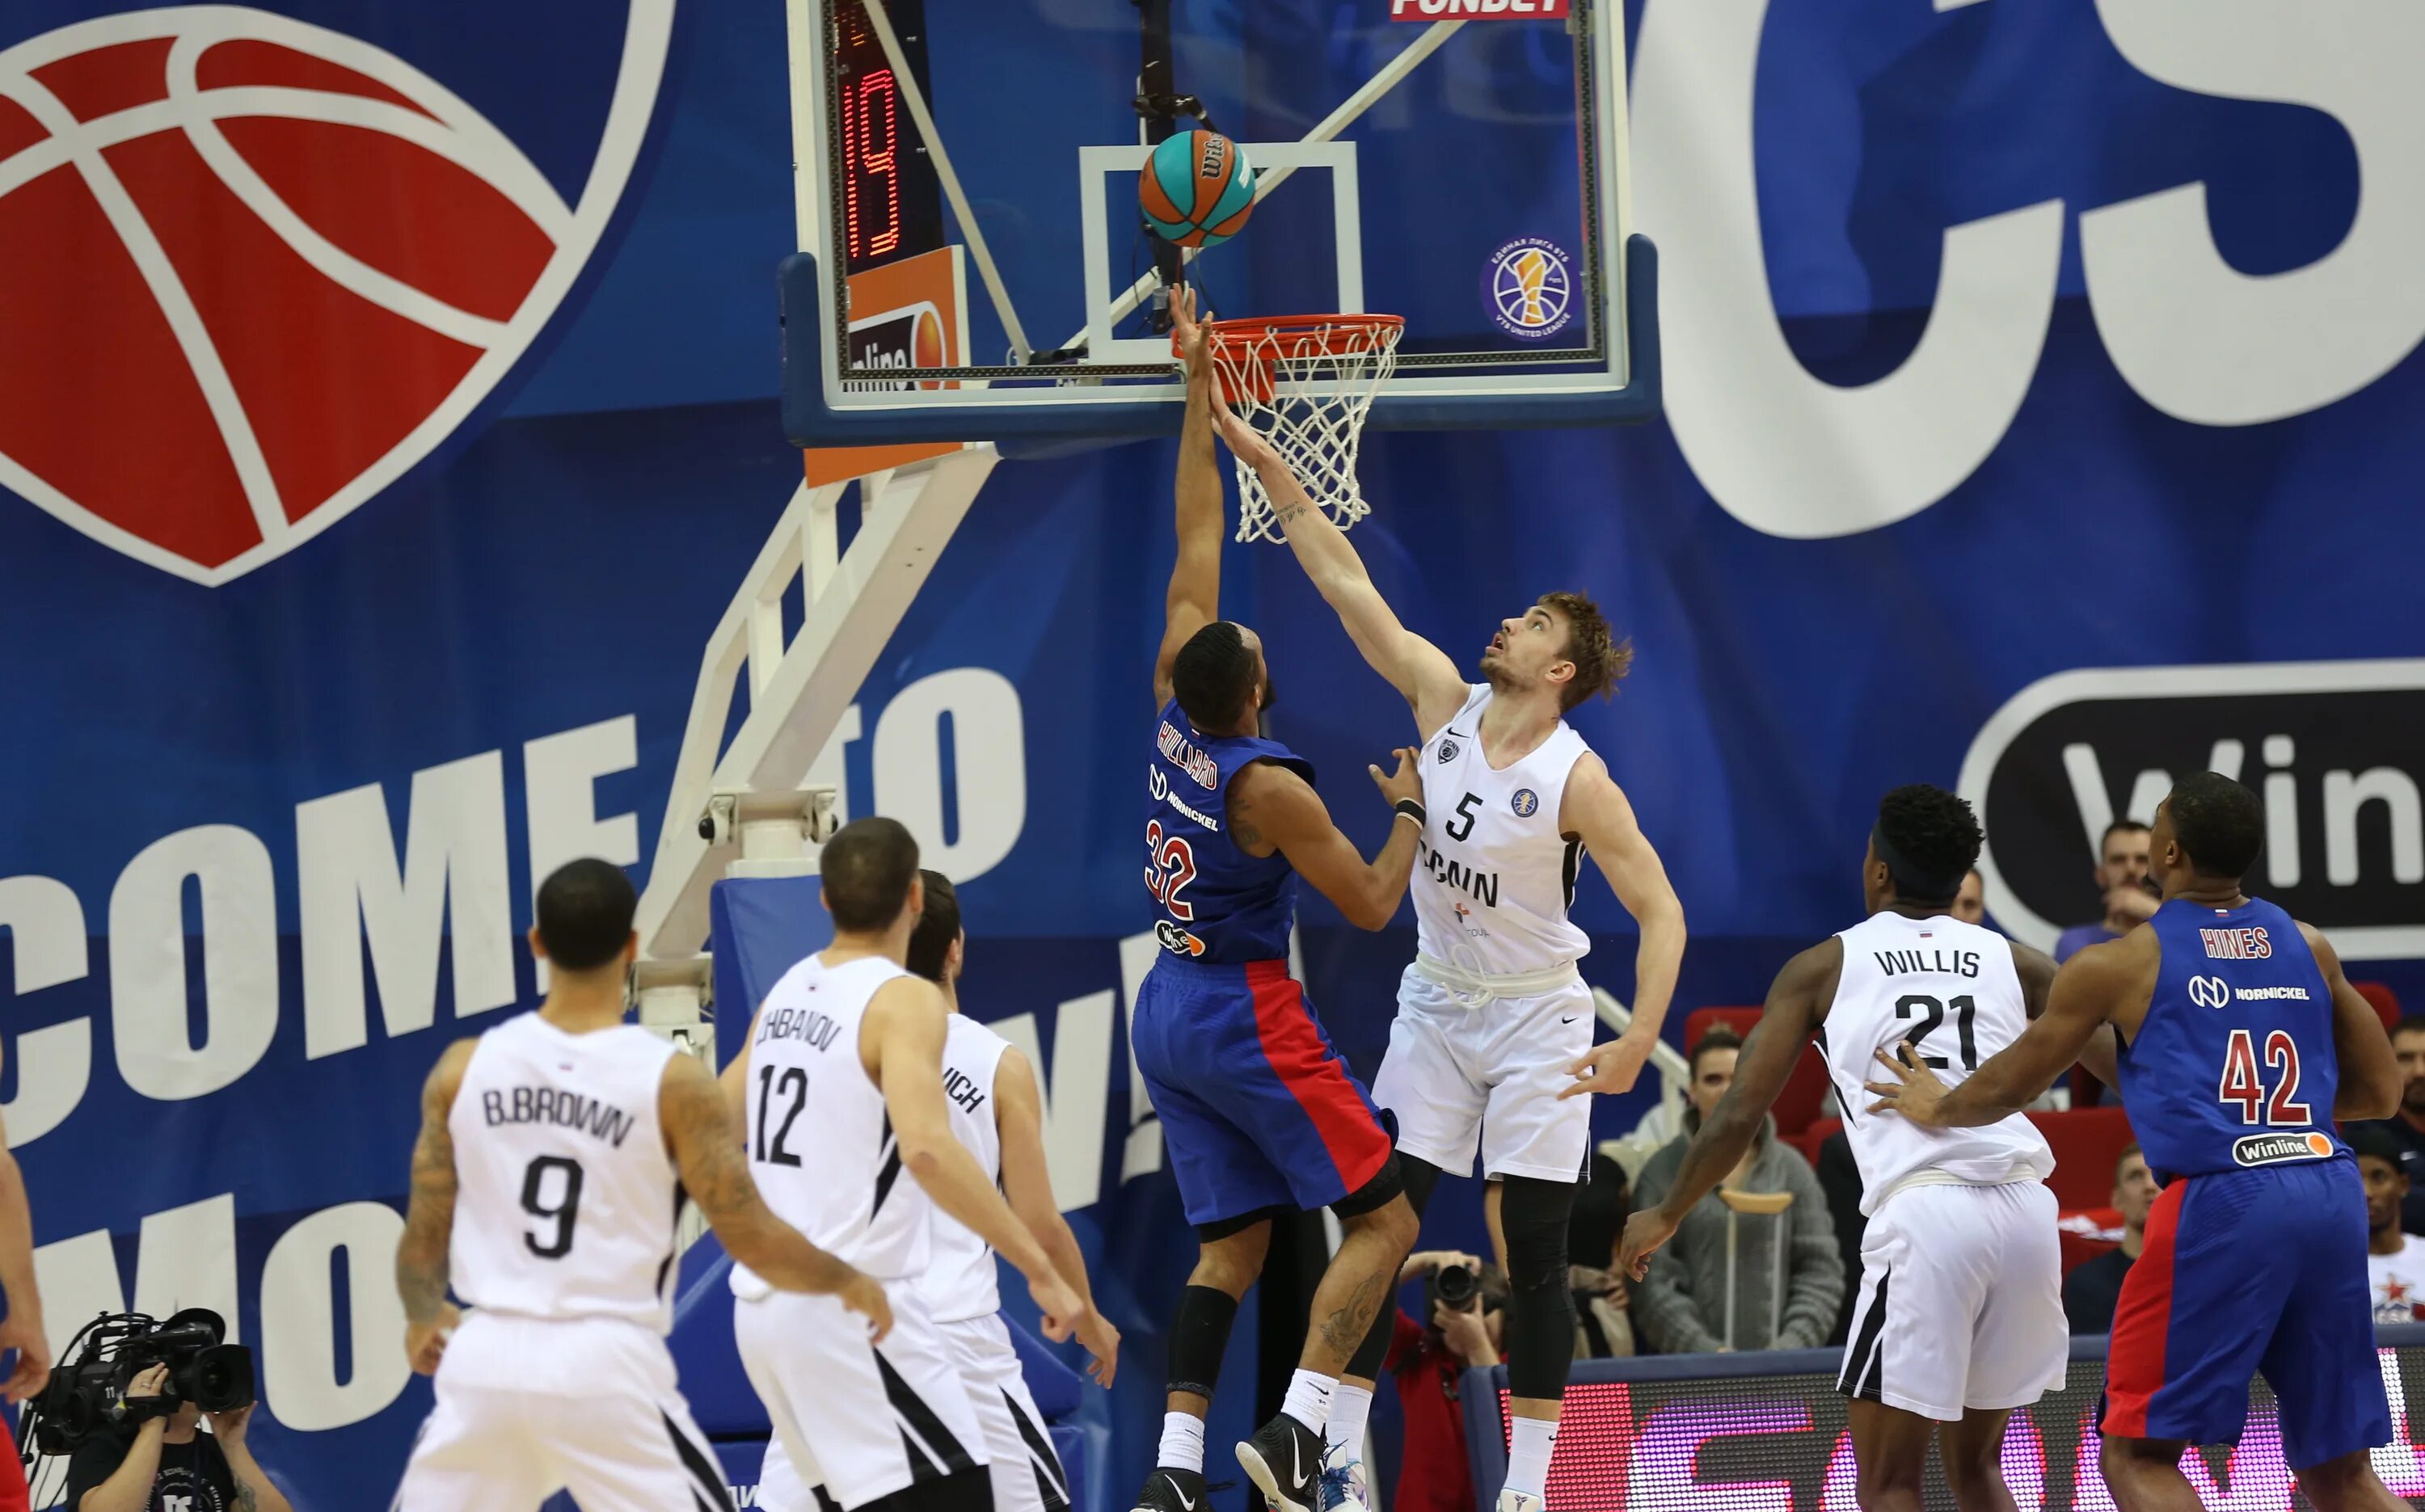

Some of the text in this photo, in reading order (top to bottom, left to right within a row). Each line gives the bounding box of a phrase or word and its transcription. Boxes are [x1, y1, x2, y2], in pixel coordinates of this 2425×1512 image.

[845, 69, 897, 259] 19
[1157, 720, 1218, 791] HILLIARD
[1166, 790, 1219, 832] NORNICKEL
[1445, 792, 1483, 842] 5
[1144, 819, 1197, 921] 32
[1873, 950, 1980, 979] WILLIS
[2199, 926, 2272, 960] HINES
[2234, 987, 2310, 1001] NORNICKEL
[1895, 994, 1978, 1072] 21
[2219, 1029, 2313, 1126] 42
[483, 1086, 635, 1151] B.BROWN
[756, 1063, 808, 1168] 12
[2241, 1139, 2308, 1160] Winline
[519, 1154, 584, 1261] 9
